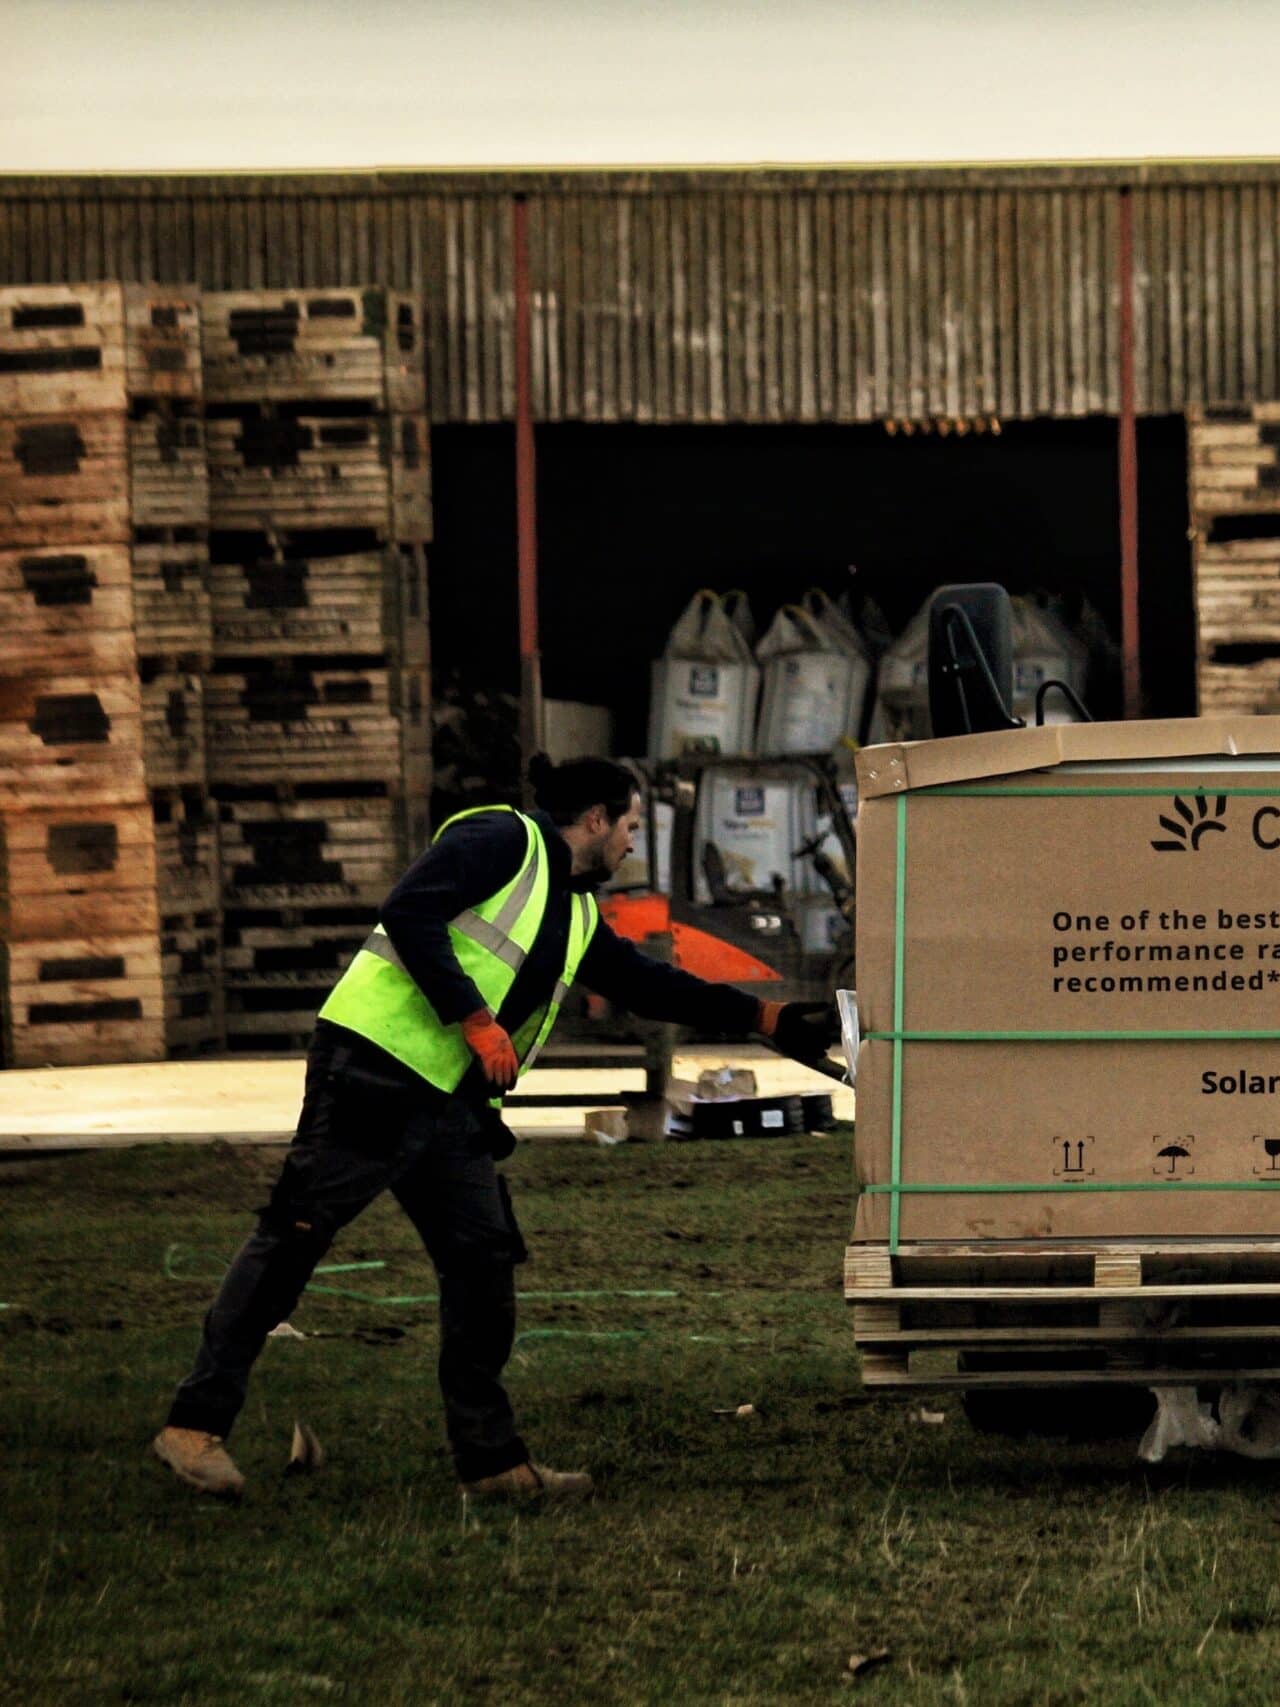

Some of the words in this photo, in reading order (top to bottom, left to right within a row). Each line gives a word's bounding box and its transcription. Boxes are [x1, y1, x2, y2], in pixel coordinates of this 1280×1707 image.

[1052, 911, 1110, 932] One
[1121, 909, 1150, 931] of
[1159, 909, 1207, 931] the
[1217, 908, 1280, 930] best
[1053, 940, 1245, 967] performance
